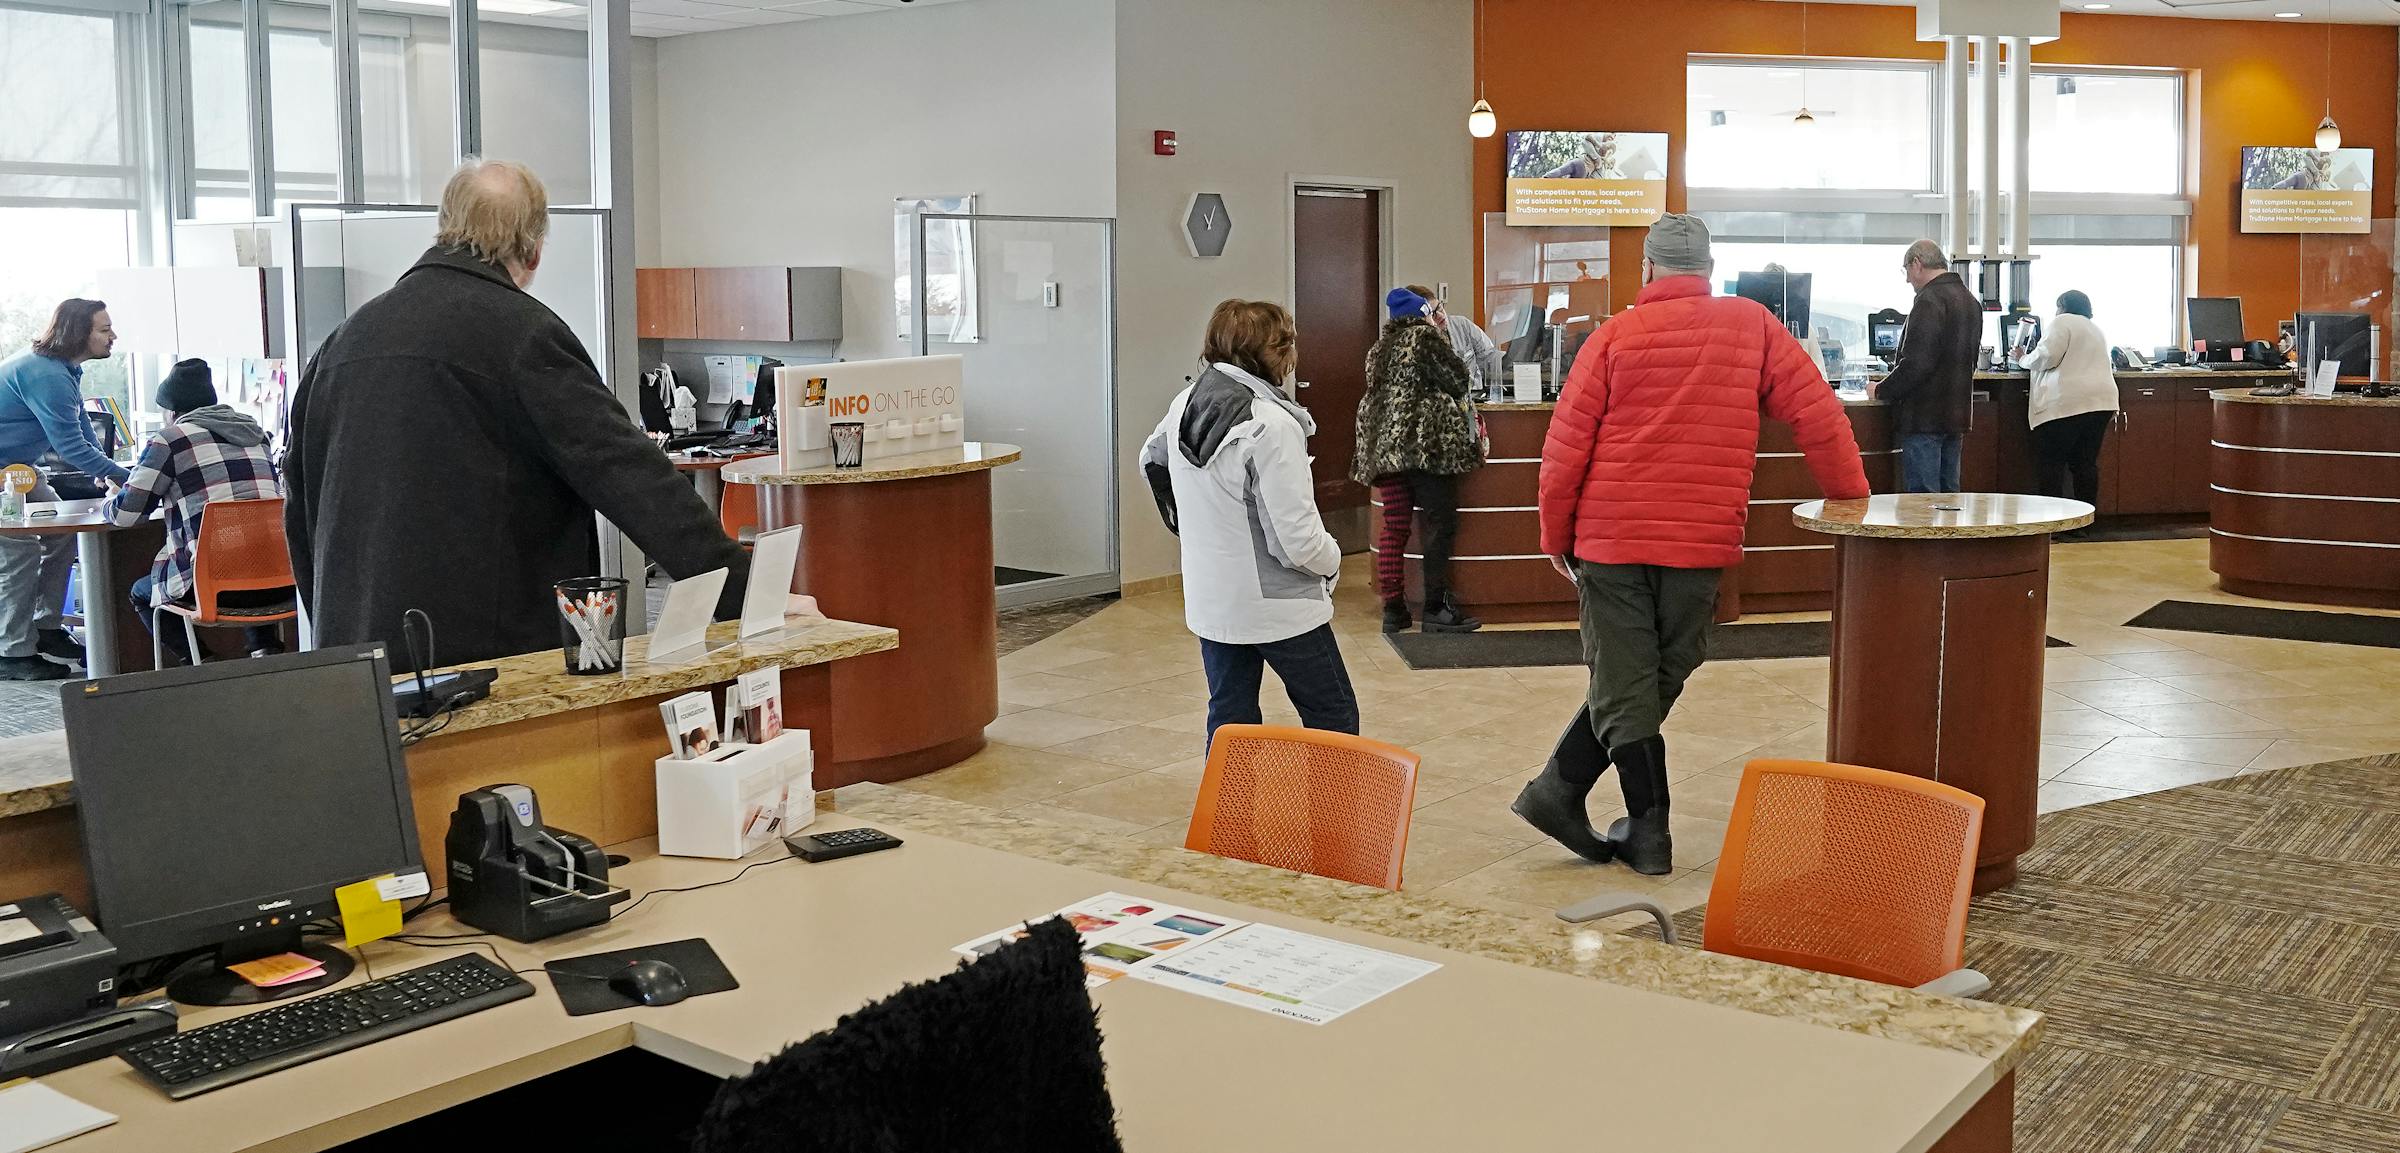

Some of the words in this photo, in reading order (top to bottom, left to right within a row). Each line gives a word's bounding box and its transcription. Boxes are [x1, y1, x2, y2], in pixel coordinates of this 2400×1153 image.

[1535, 189, 1576, 197] competitive
[1571, 208, 1605, 216] Mortgage
[1640, 208, 1657, 216] help.
[829, 394, 870, 417] INFO
[875, 392, 899, 412] ON
[904, 389, 926, 408] THE
[932, 386, 955, 405] GO
[1272, 1008, 1320, 1022] CHECKING
